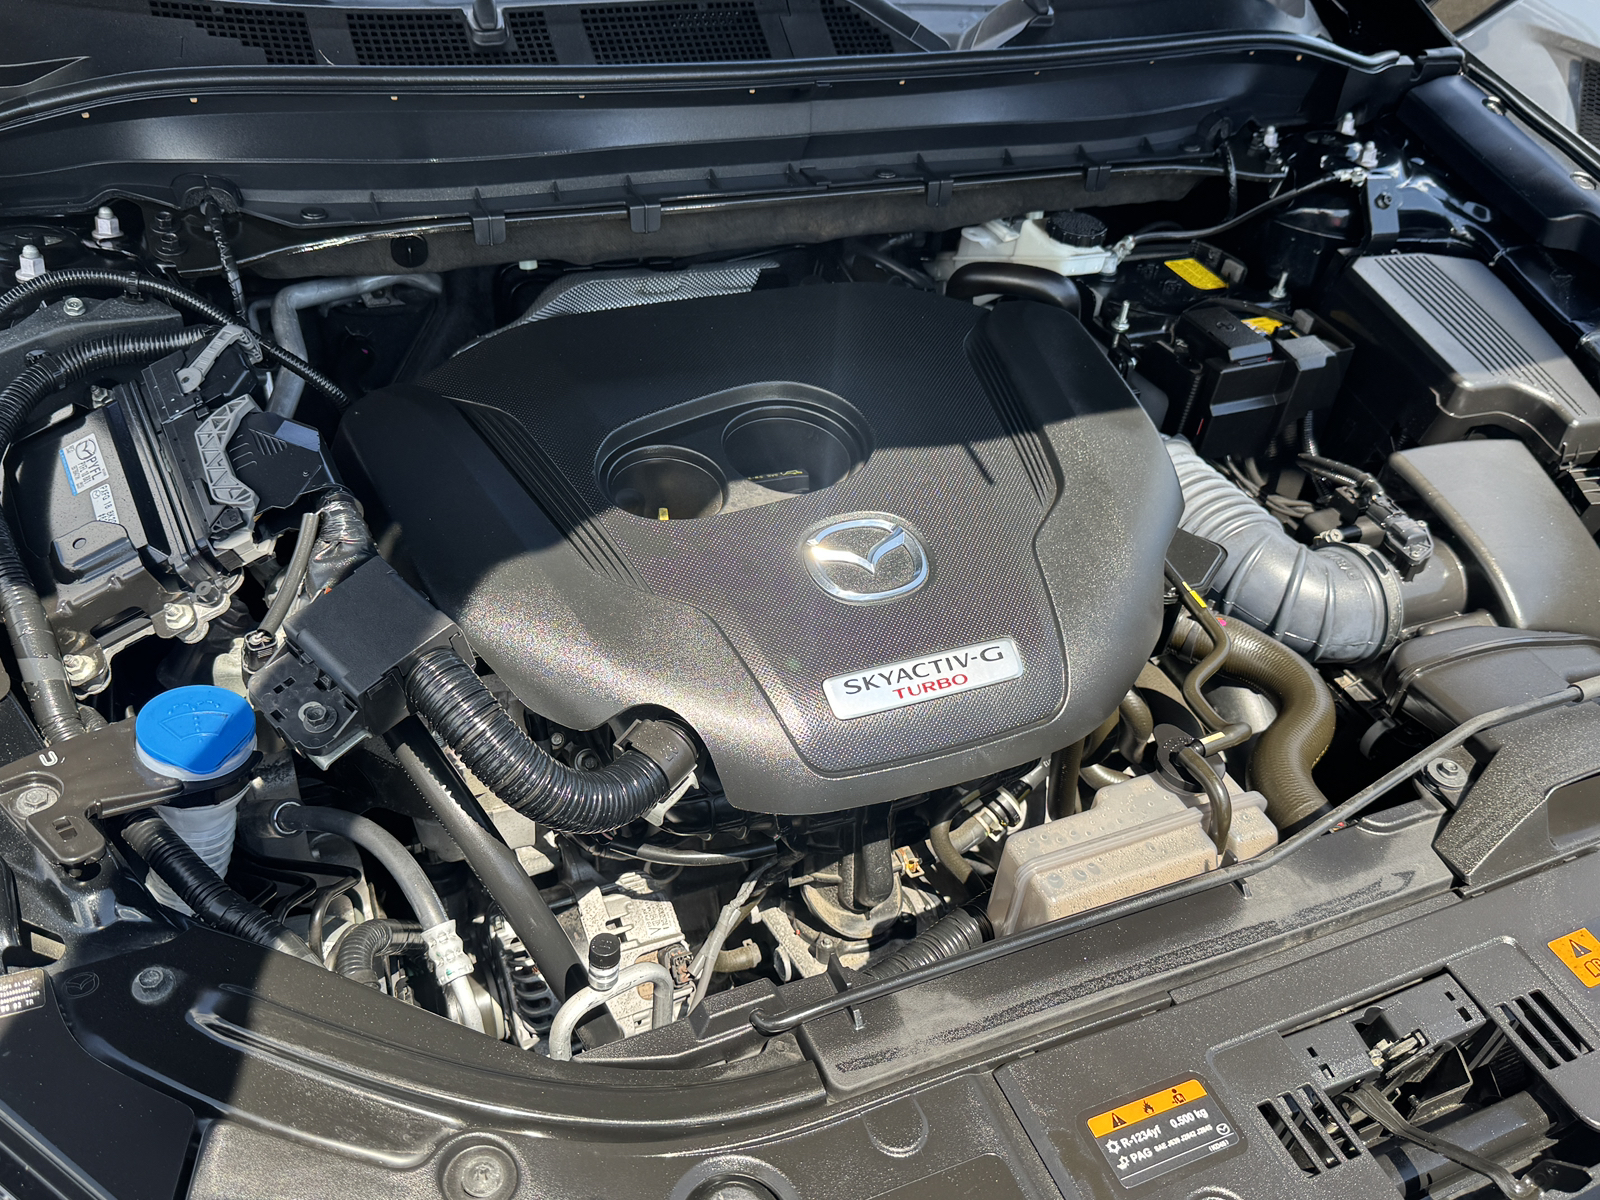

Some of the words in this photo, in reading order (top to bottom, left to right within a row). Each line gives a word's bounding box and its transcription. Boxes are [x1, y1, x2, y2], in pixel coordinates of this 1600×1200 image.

[89, 456, 102, 480] PYFL
[843, 646, 1004, 695] SKYACTIV-G
[892, 674, 968, 699] TURBO
[1120, 1124, 1161, 1149] R-1234yf
[1169, 1112, 1195, 1128] 0.500
[1193, 1107, 1209, 1119] kg
[1130, 1148, 1153, 1164] PAG
[1154, 1142, 1167, 1152] SAE
